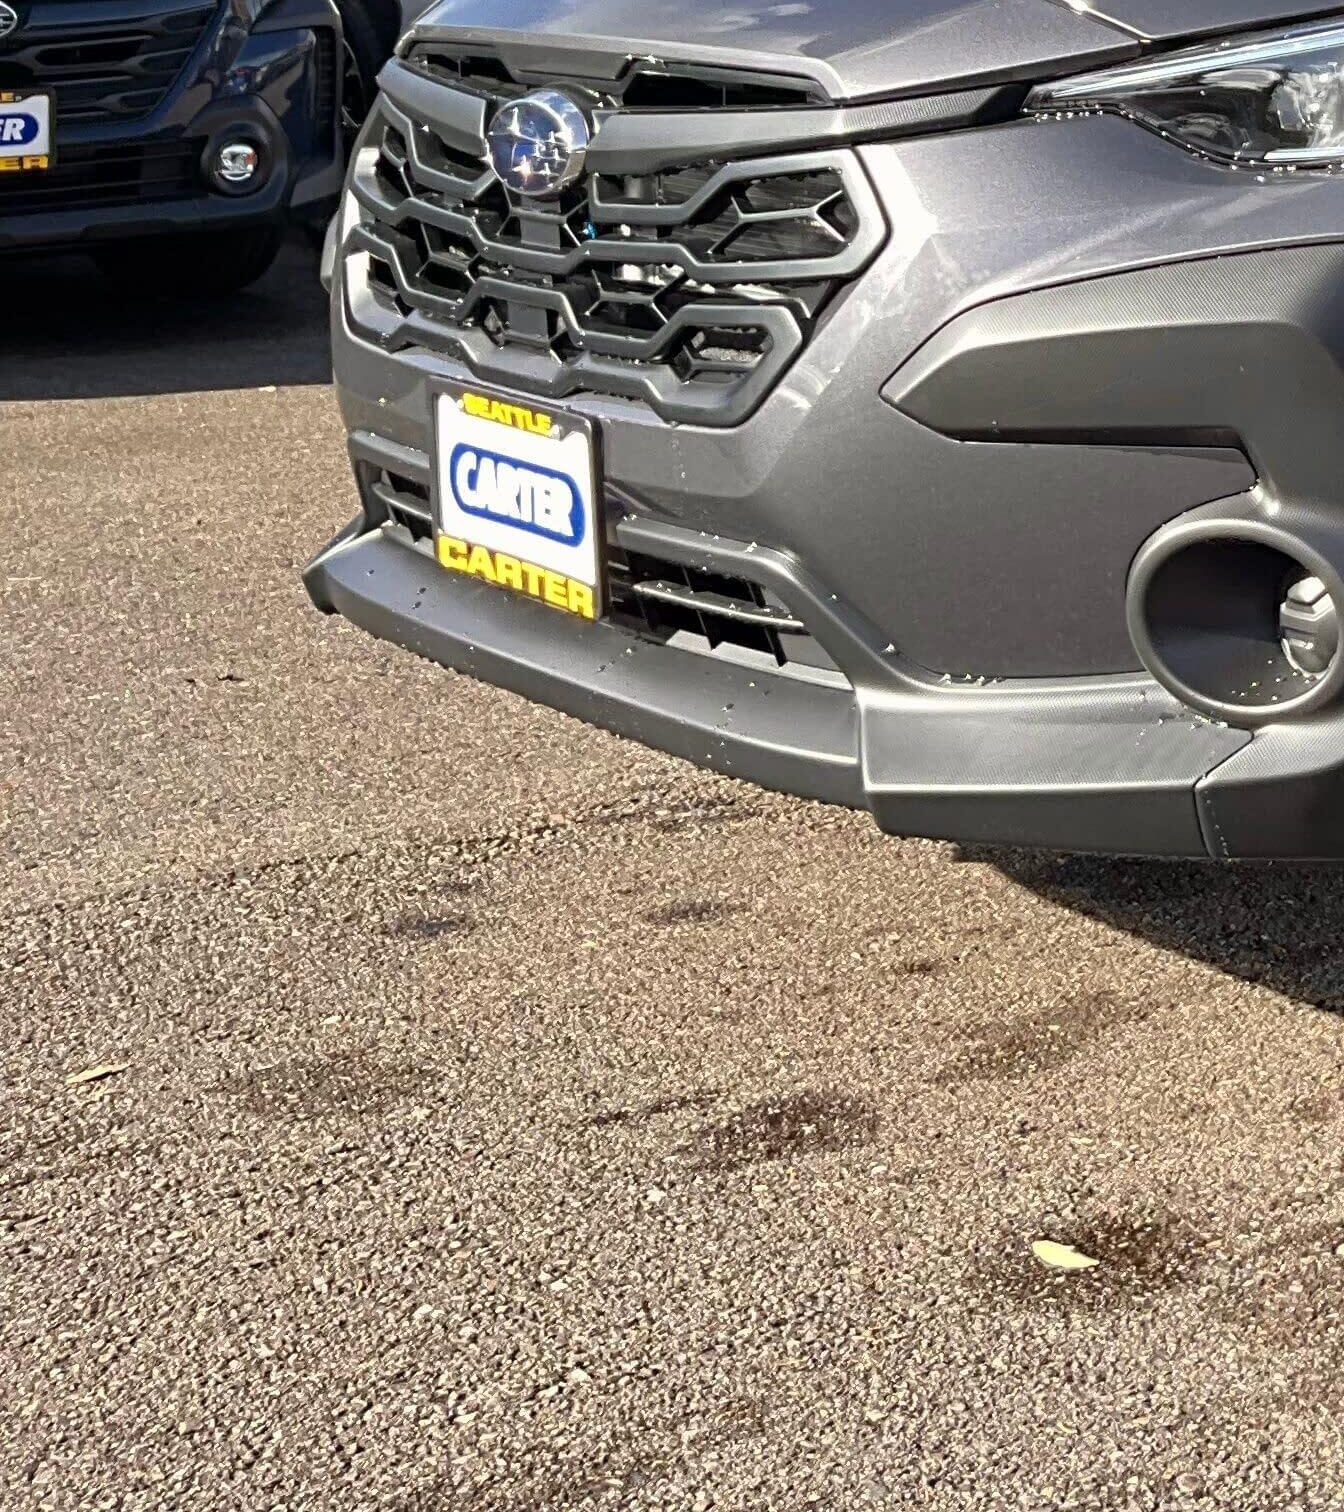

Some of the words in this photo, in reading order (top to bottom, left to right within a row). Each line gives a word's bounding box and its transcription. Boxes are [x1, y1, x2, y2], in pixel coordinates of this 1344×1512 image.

[463, 393, 552, 437] SEATTLE
[456, 451, 575, 537] CARTER
[439, 534, 594, 620] CARTER
